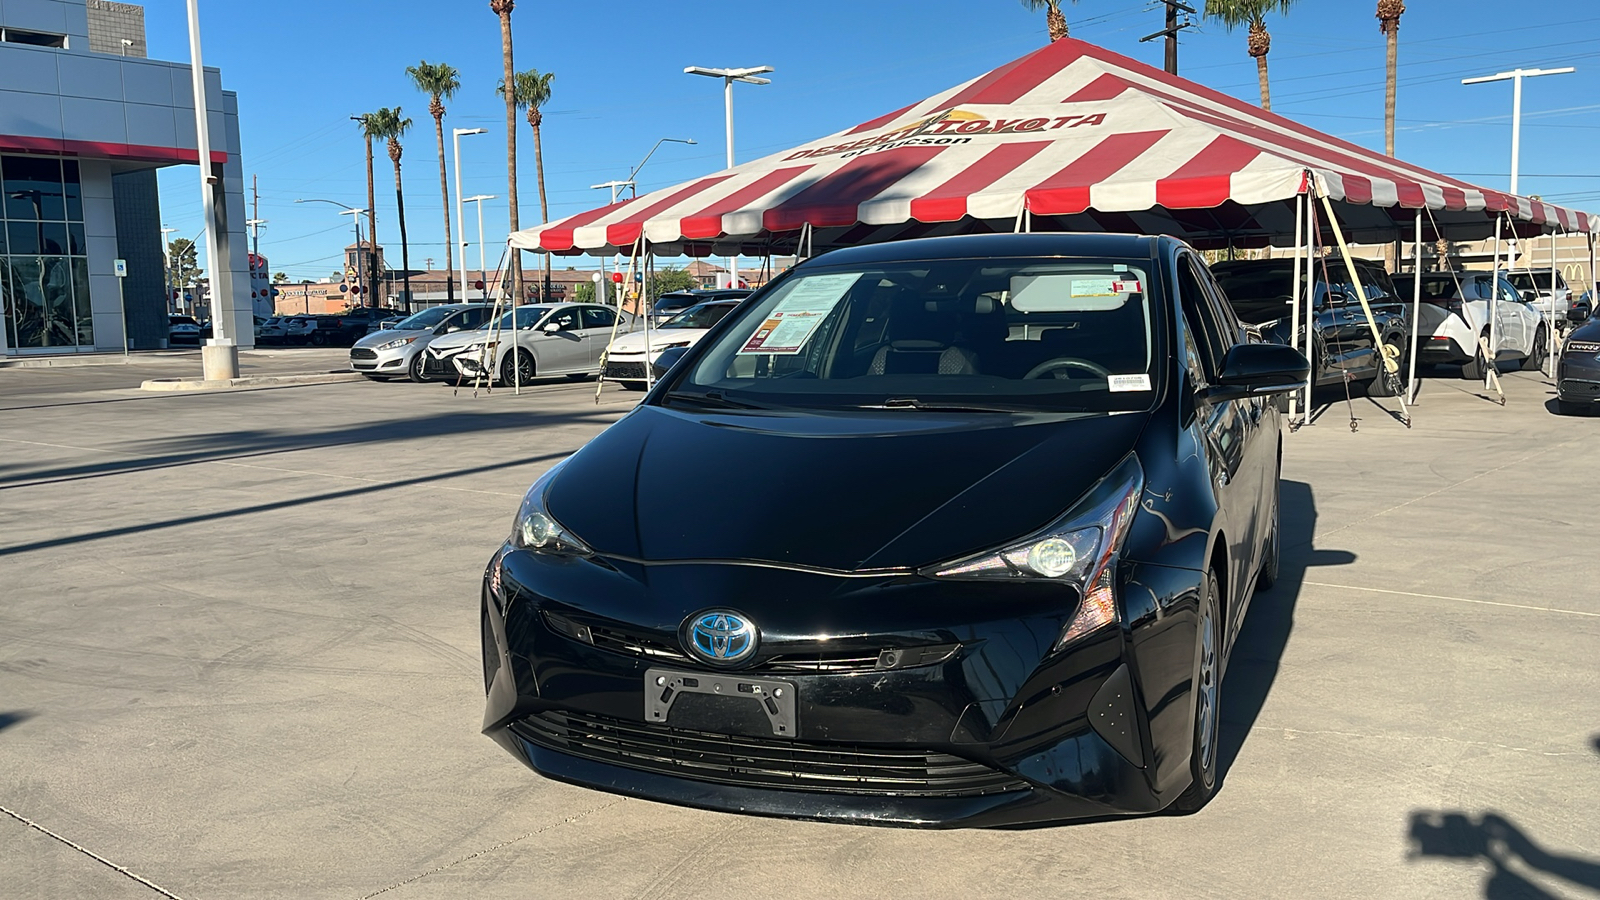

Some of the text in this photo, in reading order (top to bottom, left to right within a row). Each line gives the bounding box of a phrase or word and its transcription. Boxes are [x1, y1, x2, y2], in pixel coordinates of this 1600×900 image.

[780, 113, 1108, 162] DESERT TOYOTA
[840, 137, 973, 159] of Tucson
